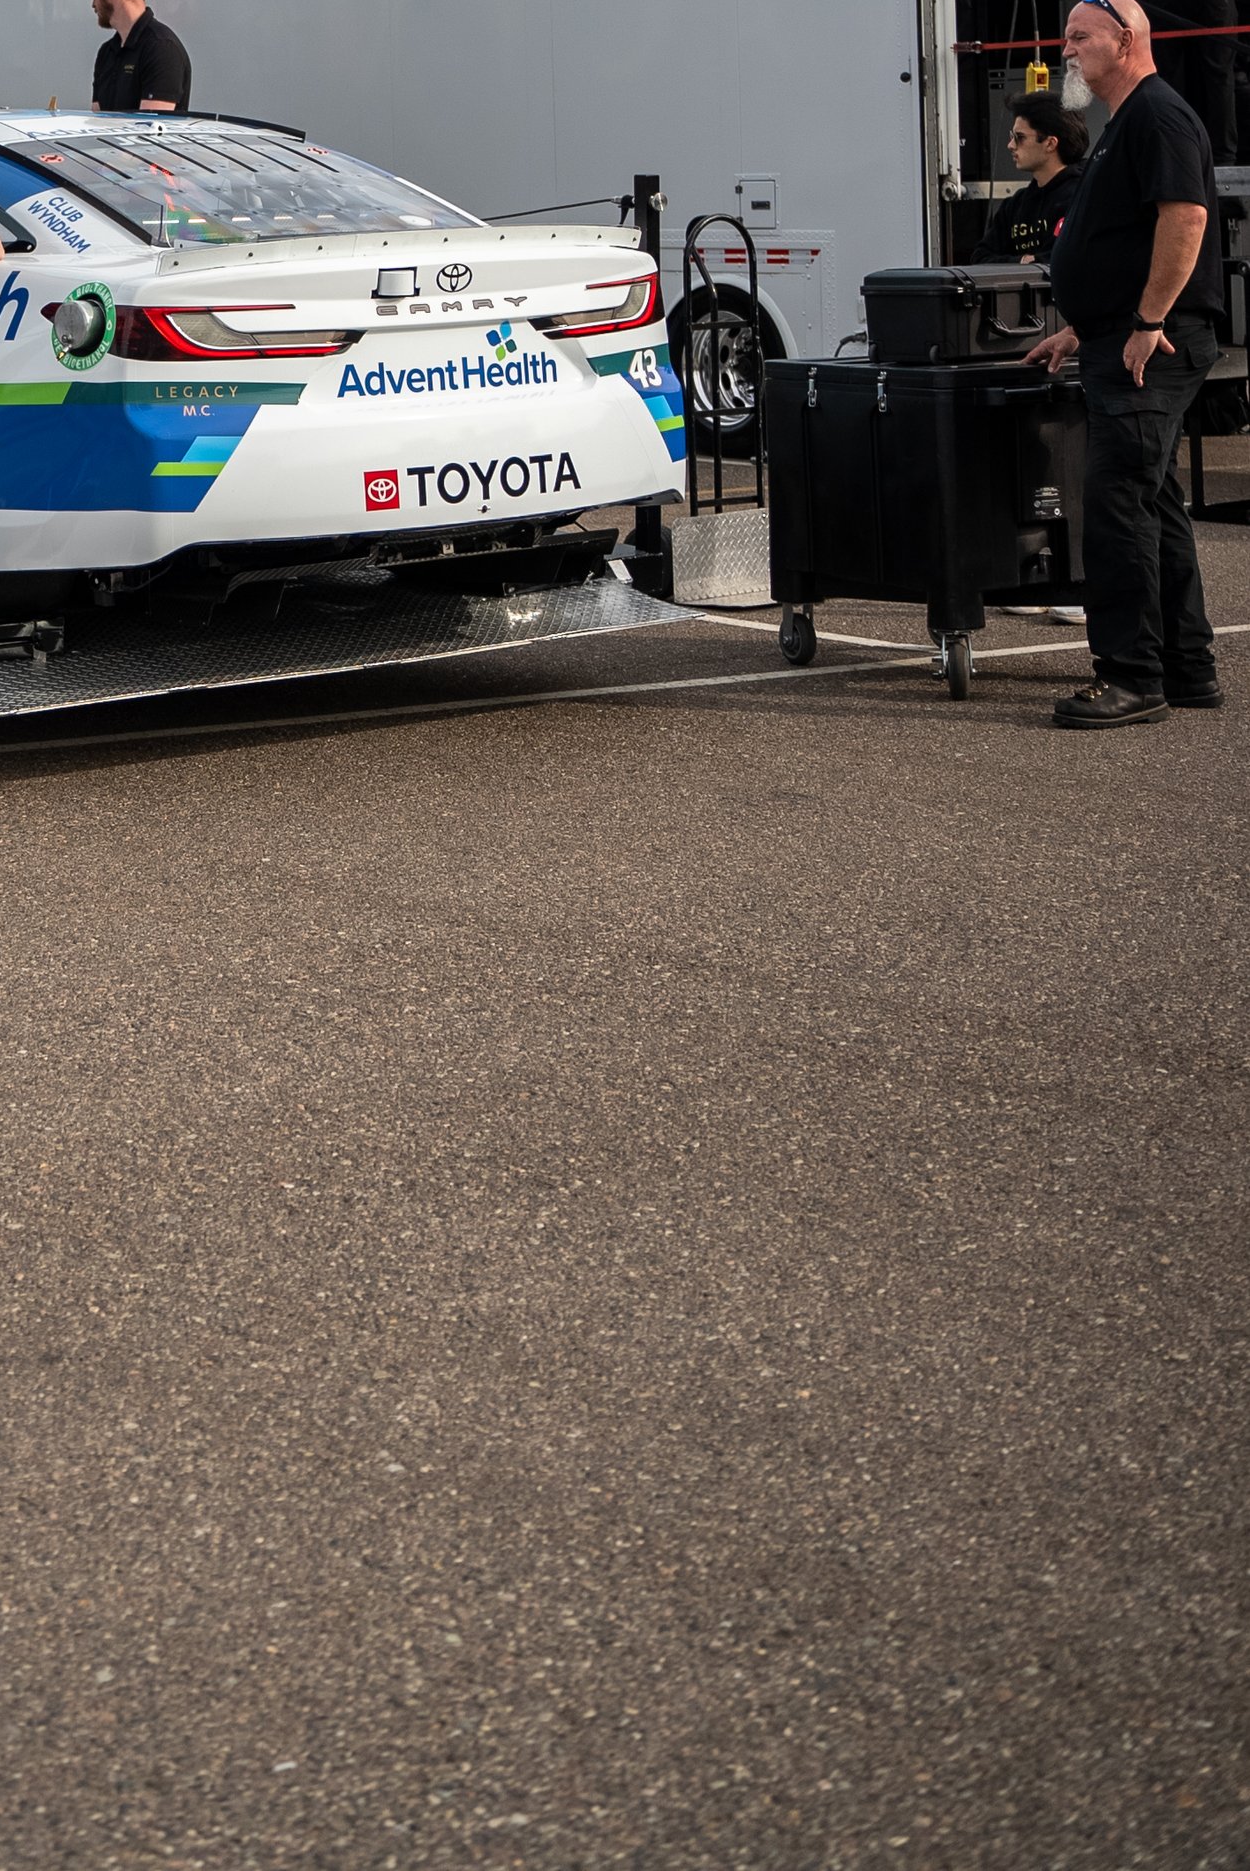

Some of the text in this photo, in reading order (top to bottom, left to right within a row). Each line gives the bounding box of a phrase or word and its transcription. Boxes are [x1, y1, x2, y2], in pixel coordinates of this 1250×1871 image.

[48, 196, 84, 223] CLUB
[27, 200, 92, 254] WYNDHAM
[376, 296, 528, 316] CAMRY
[337, 351, 558, 398] AdventHealth
[629, 349, 662, 388] 43
[155, 386, 238, 398] LEGACY
[182, 404, 215, 417] M.C.
[406, 452, 581, 507] TOYOTA
